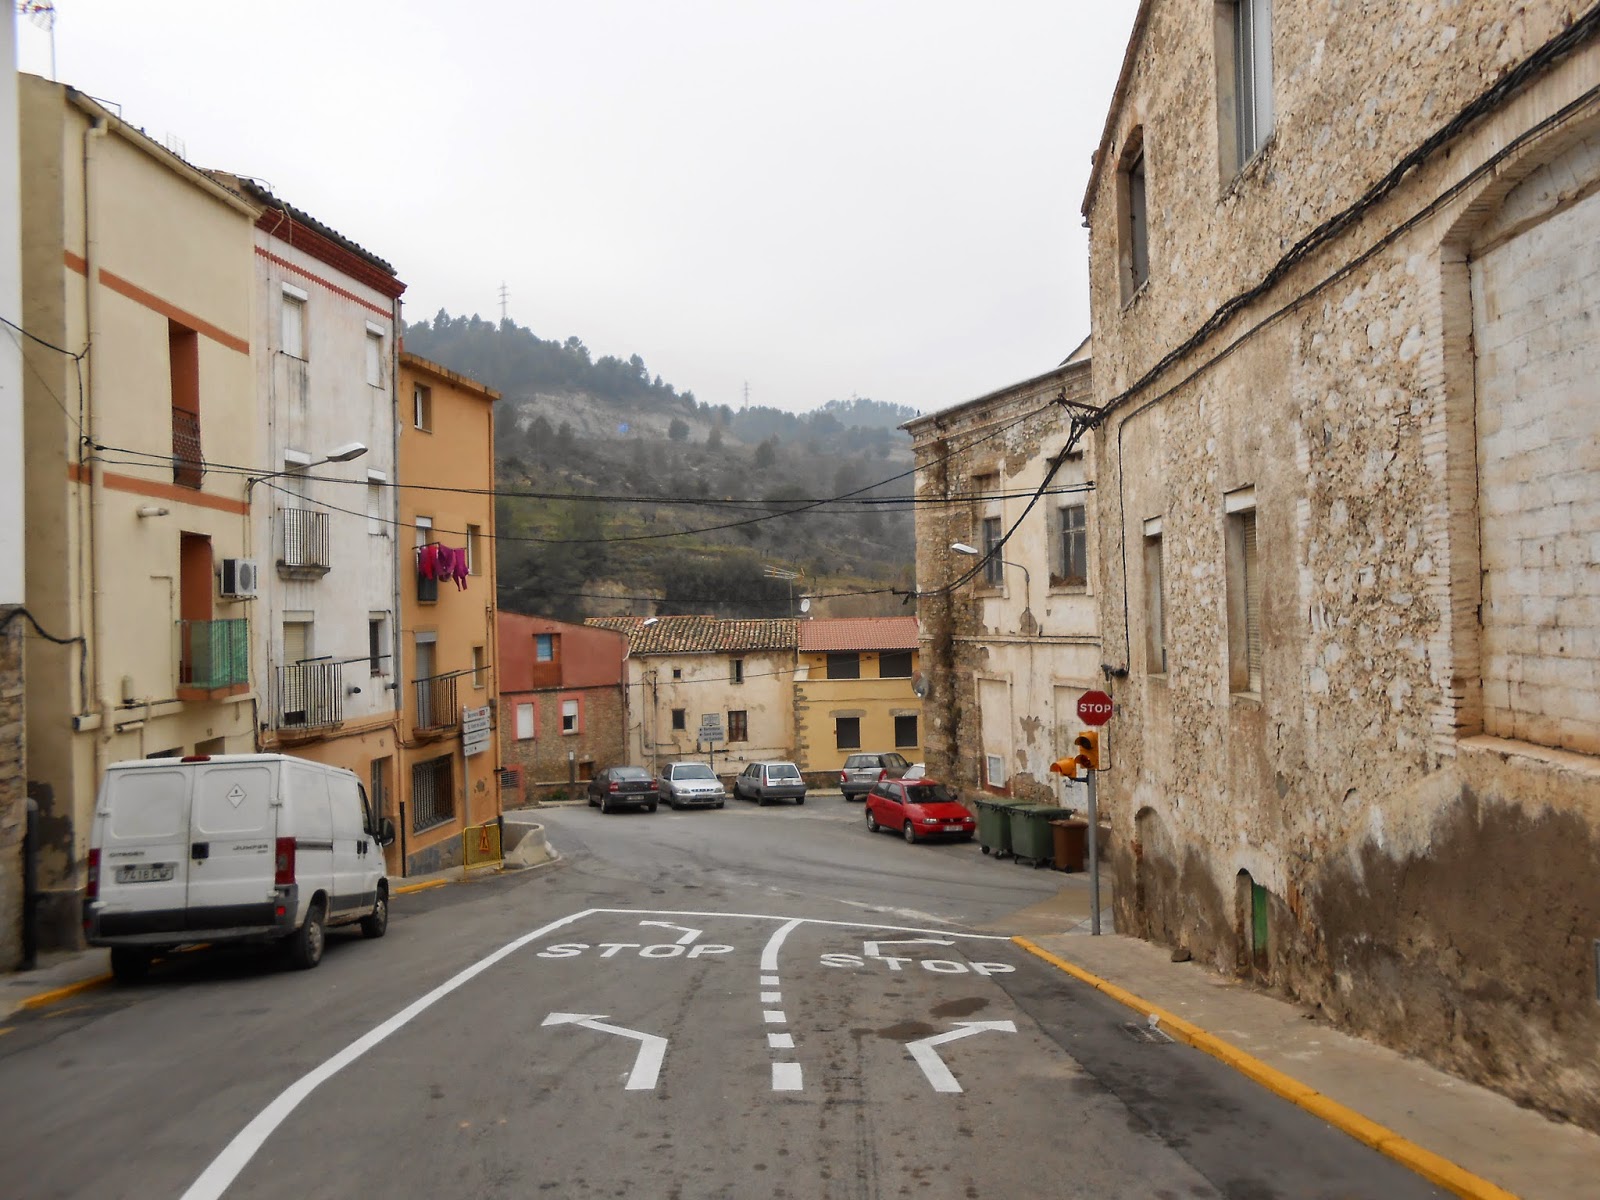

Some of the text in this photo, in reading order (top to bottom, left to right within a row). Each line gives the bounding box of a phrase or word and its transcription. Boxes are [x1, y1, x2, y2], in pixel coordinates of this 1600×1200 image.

[1080, 703, 1111, 713] STOP
[536, 943, 735, 958] STOP
[820, 953, 1016, 976] STOP
